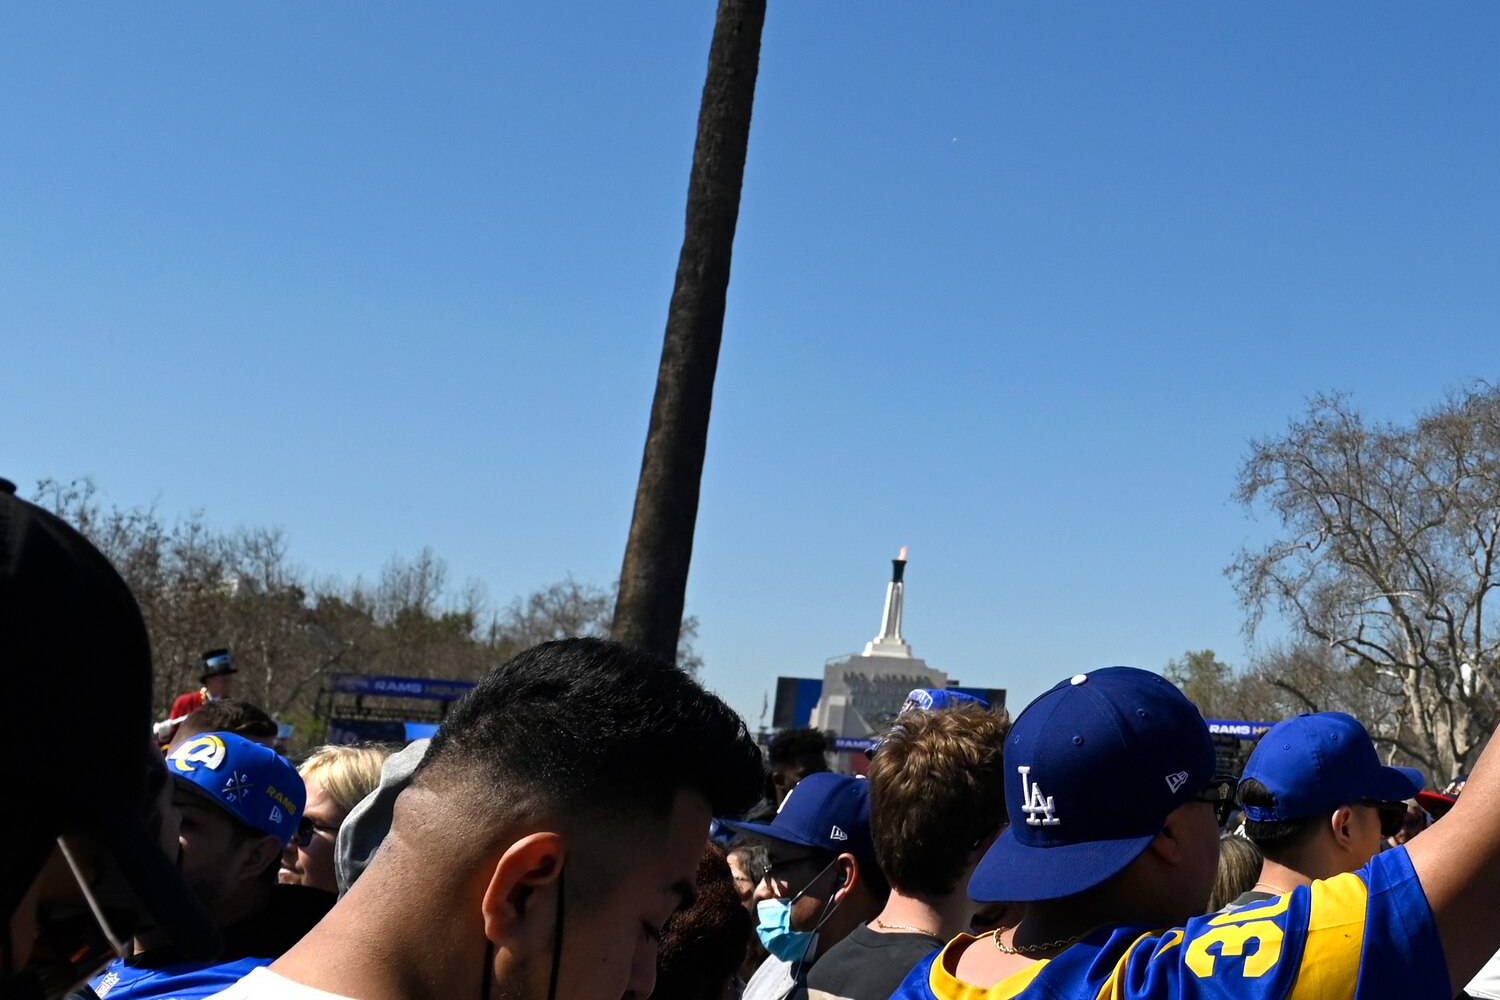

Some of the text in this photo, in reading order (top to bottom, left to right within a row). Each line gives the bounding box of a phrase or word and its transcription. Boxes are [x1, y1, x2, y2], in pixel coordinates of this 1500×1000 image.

[375, 680, 422, 693] RAMS
[1209, 724, 1250, 735] RAMS
[266, 786, 297, 815] RAMS
[1017, 765, 1061, 826] LA
